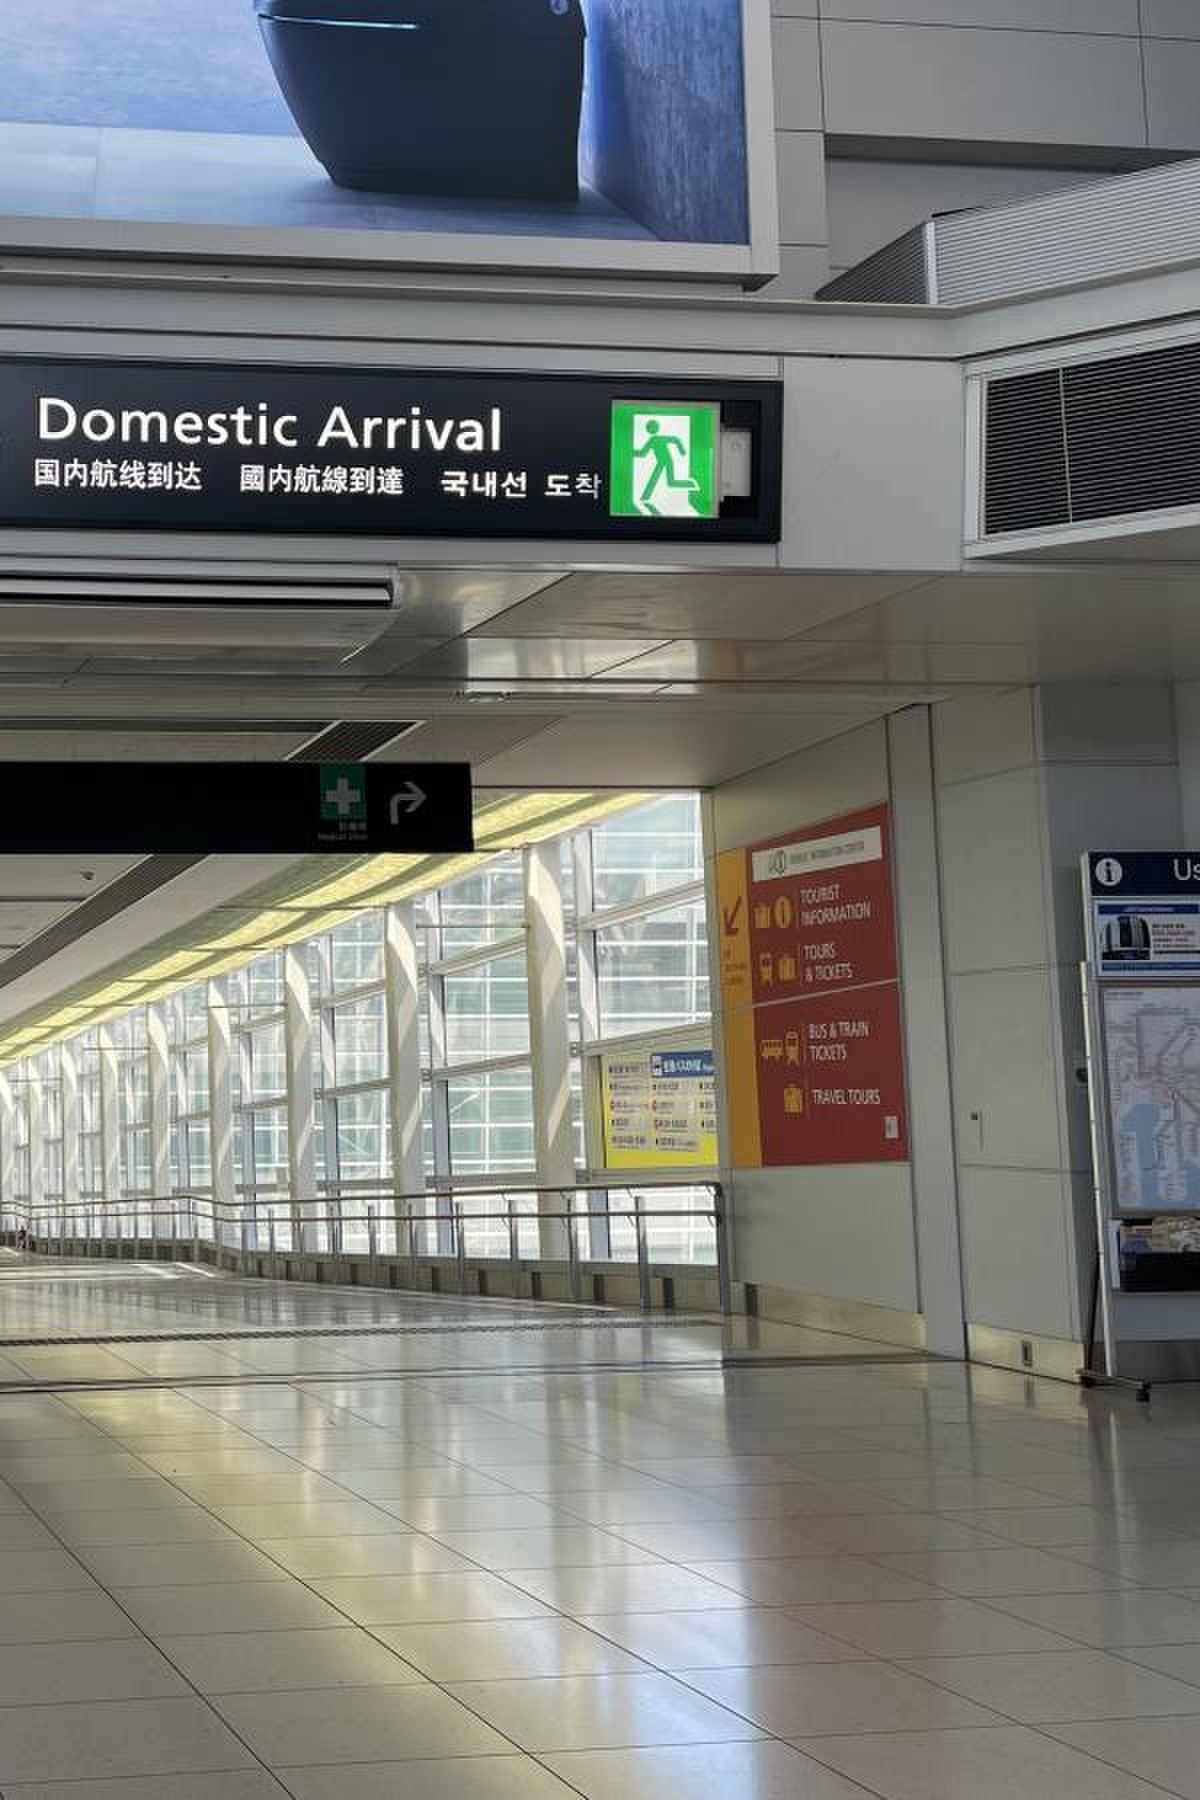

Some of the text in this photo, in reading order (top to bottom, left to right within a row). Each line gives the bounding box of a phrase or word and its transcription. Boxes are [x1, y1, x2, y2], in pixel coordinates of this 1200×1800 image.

[39, 397, 501, 452] Domestic Arrival
[34, 457, 202, 491] 国内航线到达
[440, 470, 602, 499] 국내선 도착
[800, 884, 840, 905] TOURIST
[800, 903, 872, 927] INFORMATION
[803, 943, 836, 961] TOURS
[815, 962, 853, 982] TICKETS
[808, 1023, 828, 1039] BUS
[838, 1021, 869, 1037] TRAIN
[809, 1044, 848, 1061] TICKETS
[811, 1089, 880, 1104] TRAVEL TOURS
